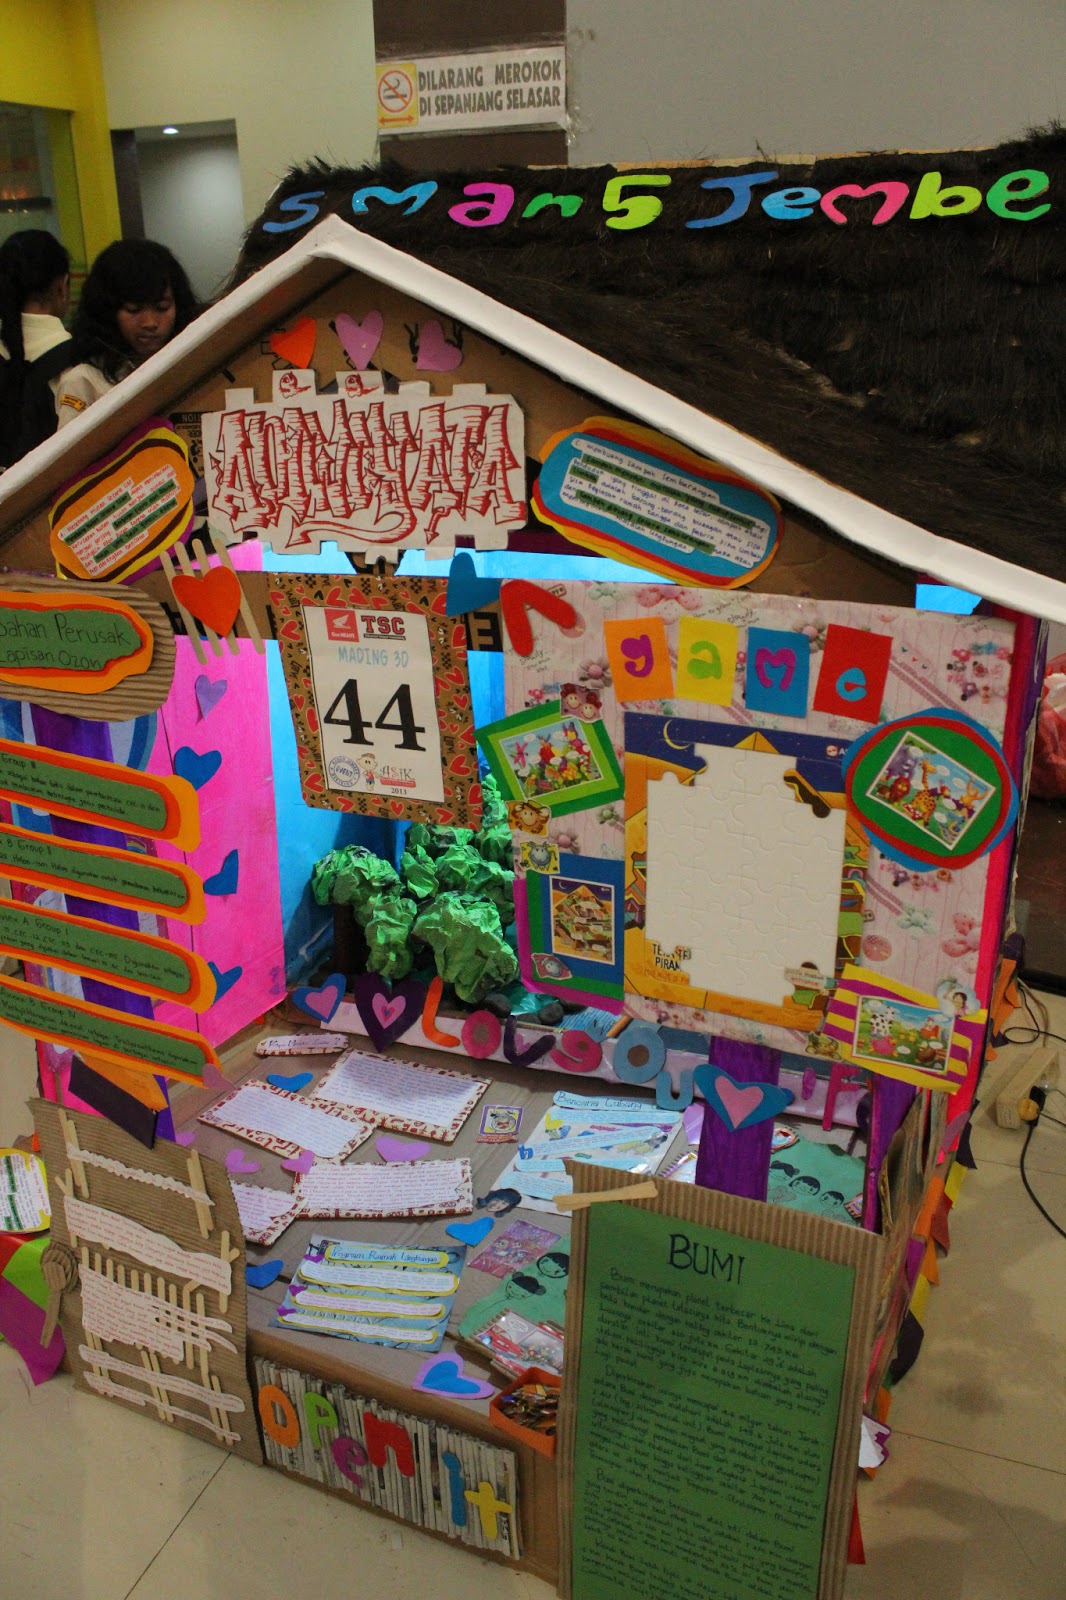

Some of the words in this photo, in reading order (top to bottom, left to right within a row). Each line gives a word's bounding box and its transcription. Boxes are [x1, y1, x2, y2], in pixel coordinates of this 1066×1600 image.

[419, 66, 483, 92] DILARANG
[495, 59, 562, 85] MEROKOK
[420, 96, 431, 116] DI
[435, 90, 503, 115] SEPANJANG
[507, 86, 561, 109] SELASAR
[54, 613, 132, 646] Perusak
[361, 615, 406, 635] TSC
[58, 650, 100, 669] Ozon
[338, 646, 388, 666] MADING
[394, 650, 410, 668] 3D
[323, 678, 427, 752] 44
[667, 1233, 745, 1285] BUMI
